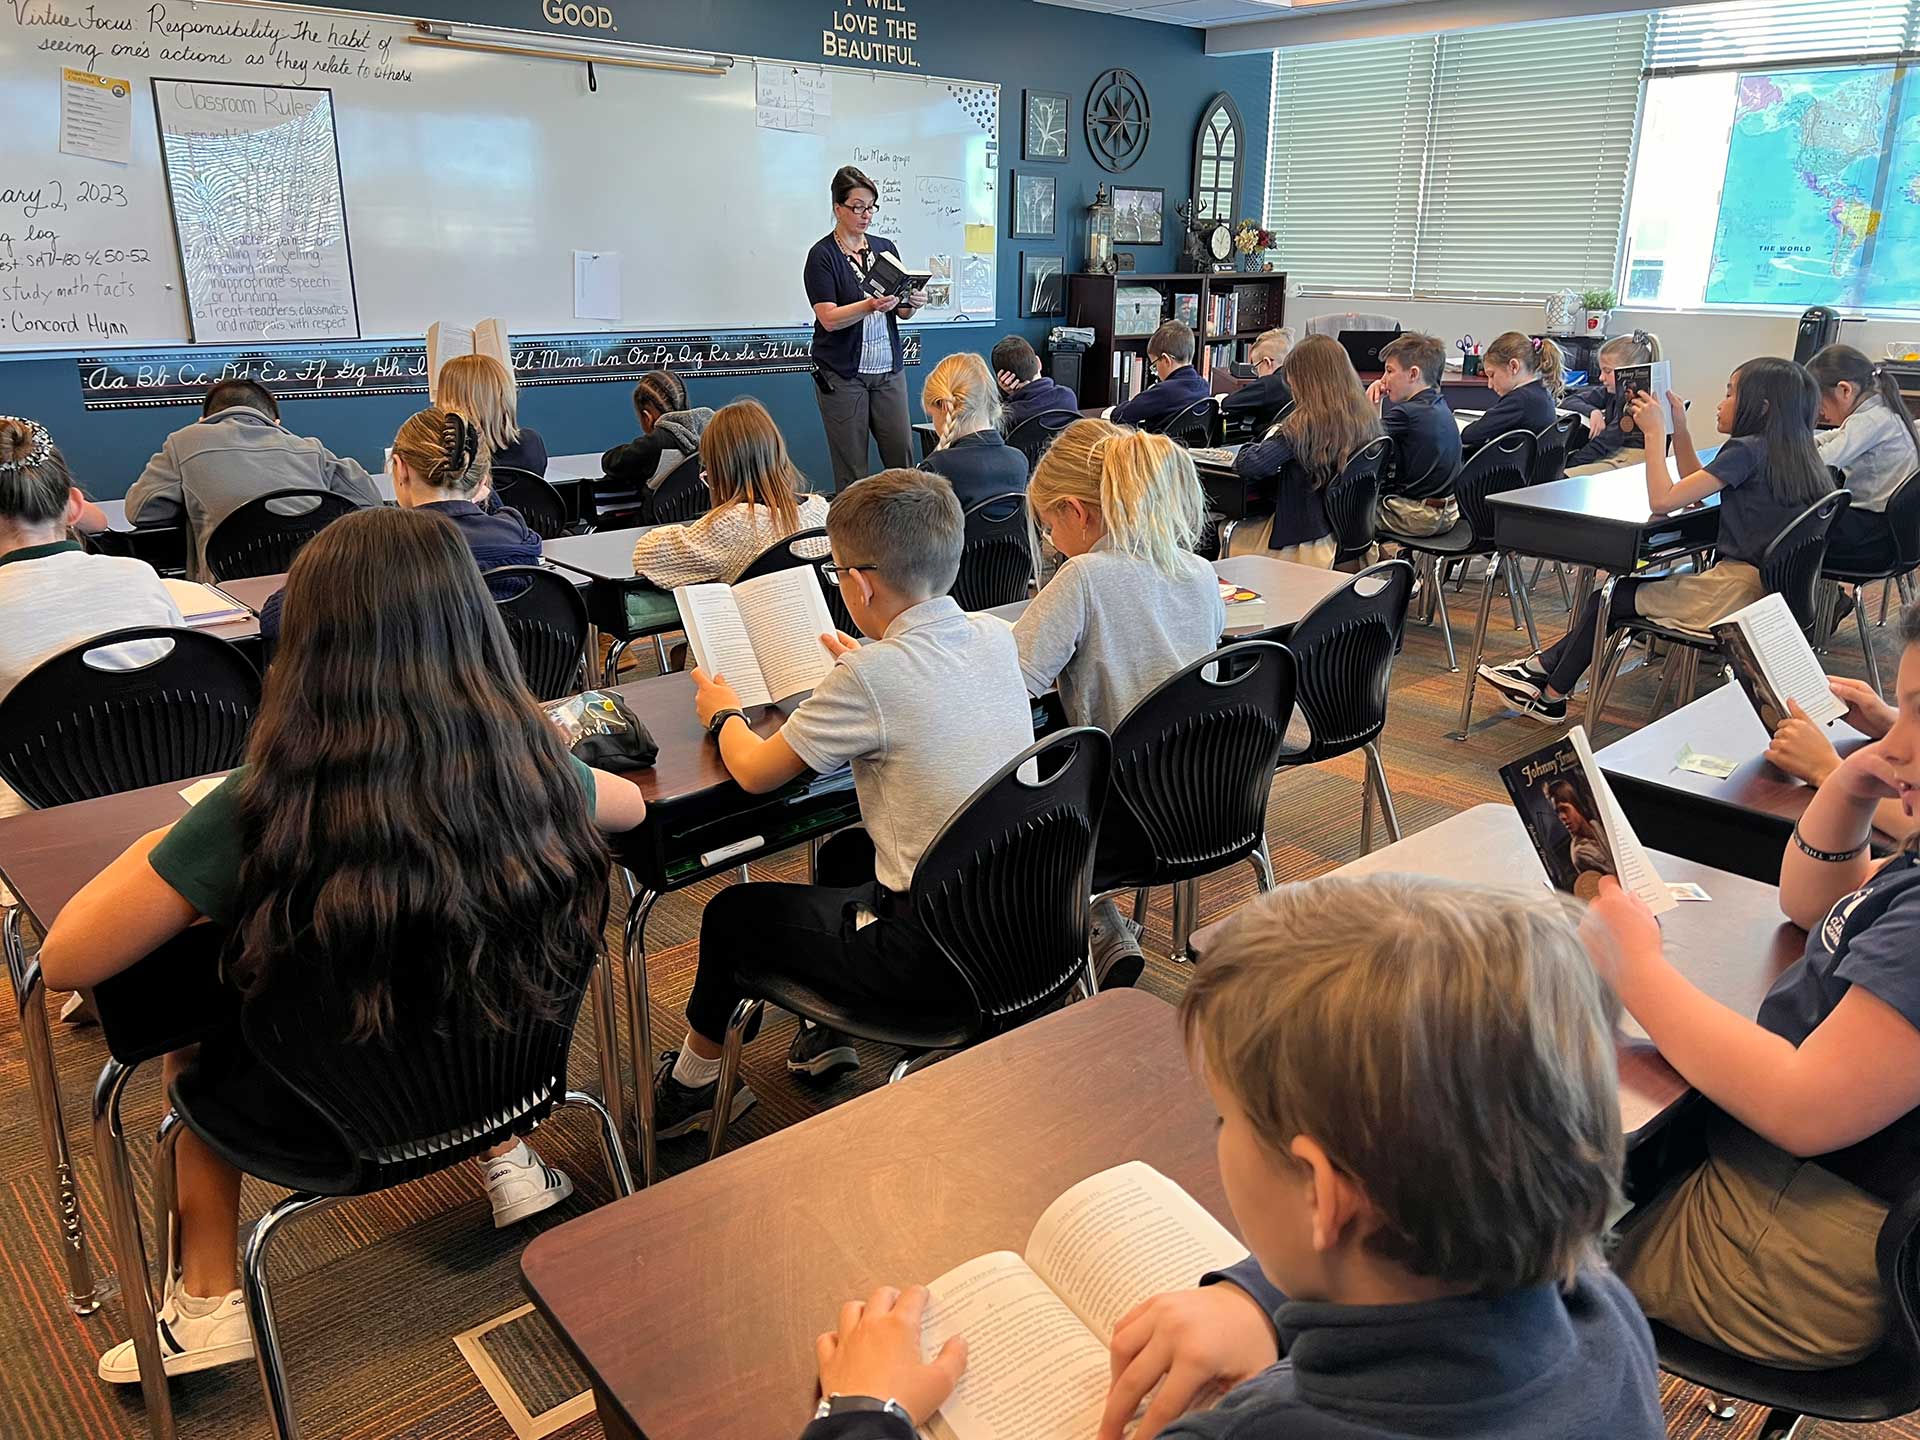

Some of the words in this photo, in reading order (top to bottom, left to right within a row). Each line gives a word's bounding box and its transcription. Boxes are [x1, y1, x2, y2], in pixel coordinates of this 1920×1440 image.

[543, 0, 618, 33] GOOD.
[833, 11, 878, 35] LOVE
[886, 19, 917, 40] THE
[8, 0, 78, 27] Virtue
[290, 21, 321, 43] The
[327, 23, 371, 48] habit
[378, 36, 393, 64] of
[37, 37, 103, 72] seeing
[160, 45, 232, 65] actions
[245, 54, 265, 65] as
[275, 50, 308, 85] they
[312, 55, 352, 75] relate
[357, 58, 371, 80] to
[823, 30, 920, 67] BEAUTIFUL.
[175, 84, 257, 114] Classroom
[264, 88, 315, 118] Rules
[77, 181, 128, 207] 2023
[104, 249, 151, 263] 50-52
[2, 276, 52, 305] study
[57, 274, 89, 297] math
[94, 272, 136, 297] facts
[289, 277, 332, 292] speech
[205, 302, 243, 318] Treat
[299, 301, 349, 317] classmates
[12, 311, 79, 334] Concord
[87, 313, 129, 339] Hymn
[216, 319, 238, 332] and
[288, 318, 310, 329] with
[313, 317, 347, 334] respect
[88, 366, 129, 390] Aa
[136, 364, 171, 388] Bb
[178, 363, 208, 386] Cc
[260, 360, 288, 383] Ee
[296, 359, 327, 389] Ff
[372, 356, 403, 377] Hh
[511, 350, 534, 370] Ll
[539, 349, 584, 369] Mm
[590, 347, 622, 367] Nn
[627, 346, 650, 365] Oo
[654, 345, 675, 371] Pp
[678, 344, 704, 371] Qq
[708, 343, 731, 362] Rr
[759, 341, 778, 359] Tt
[782, 341, 805, 358] Uu
[1521, 760, 1559, 787] Johnny
